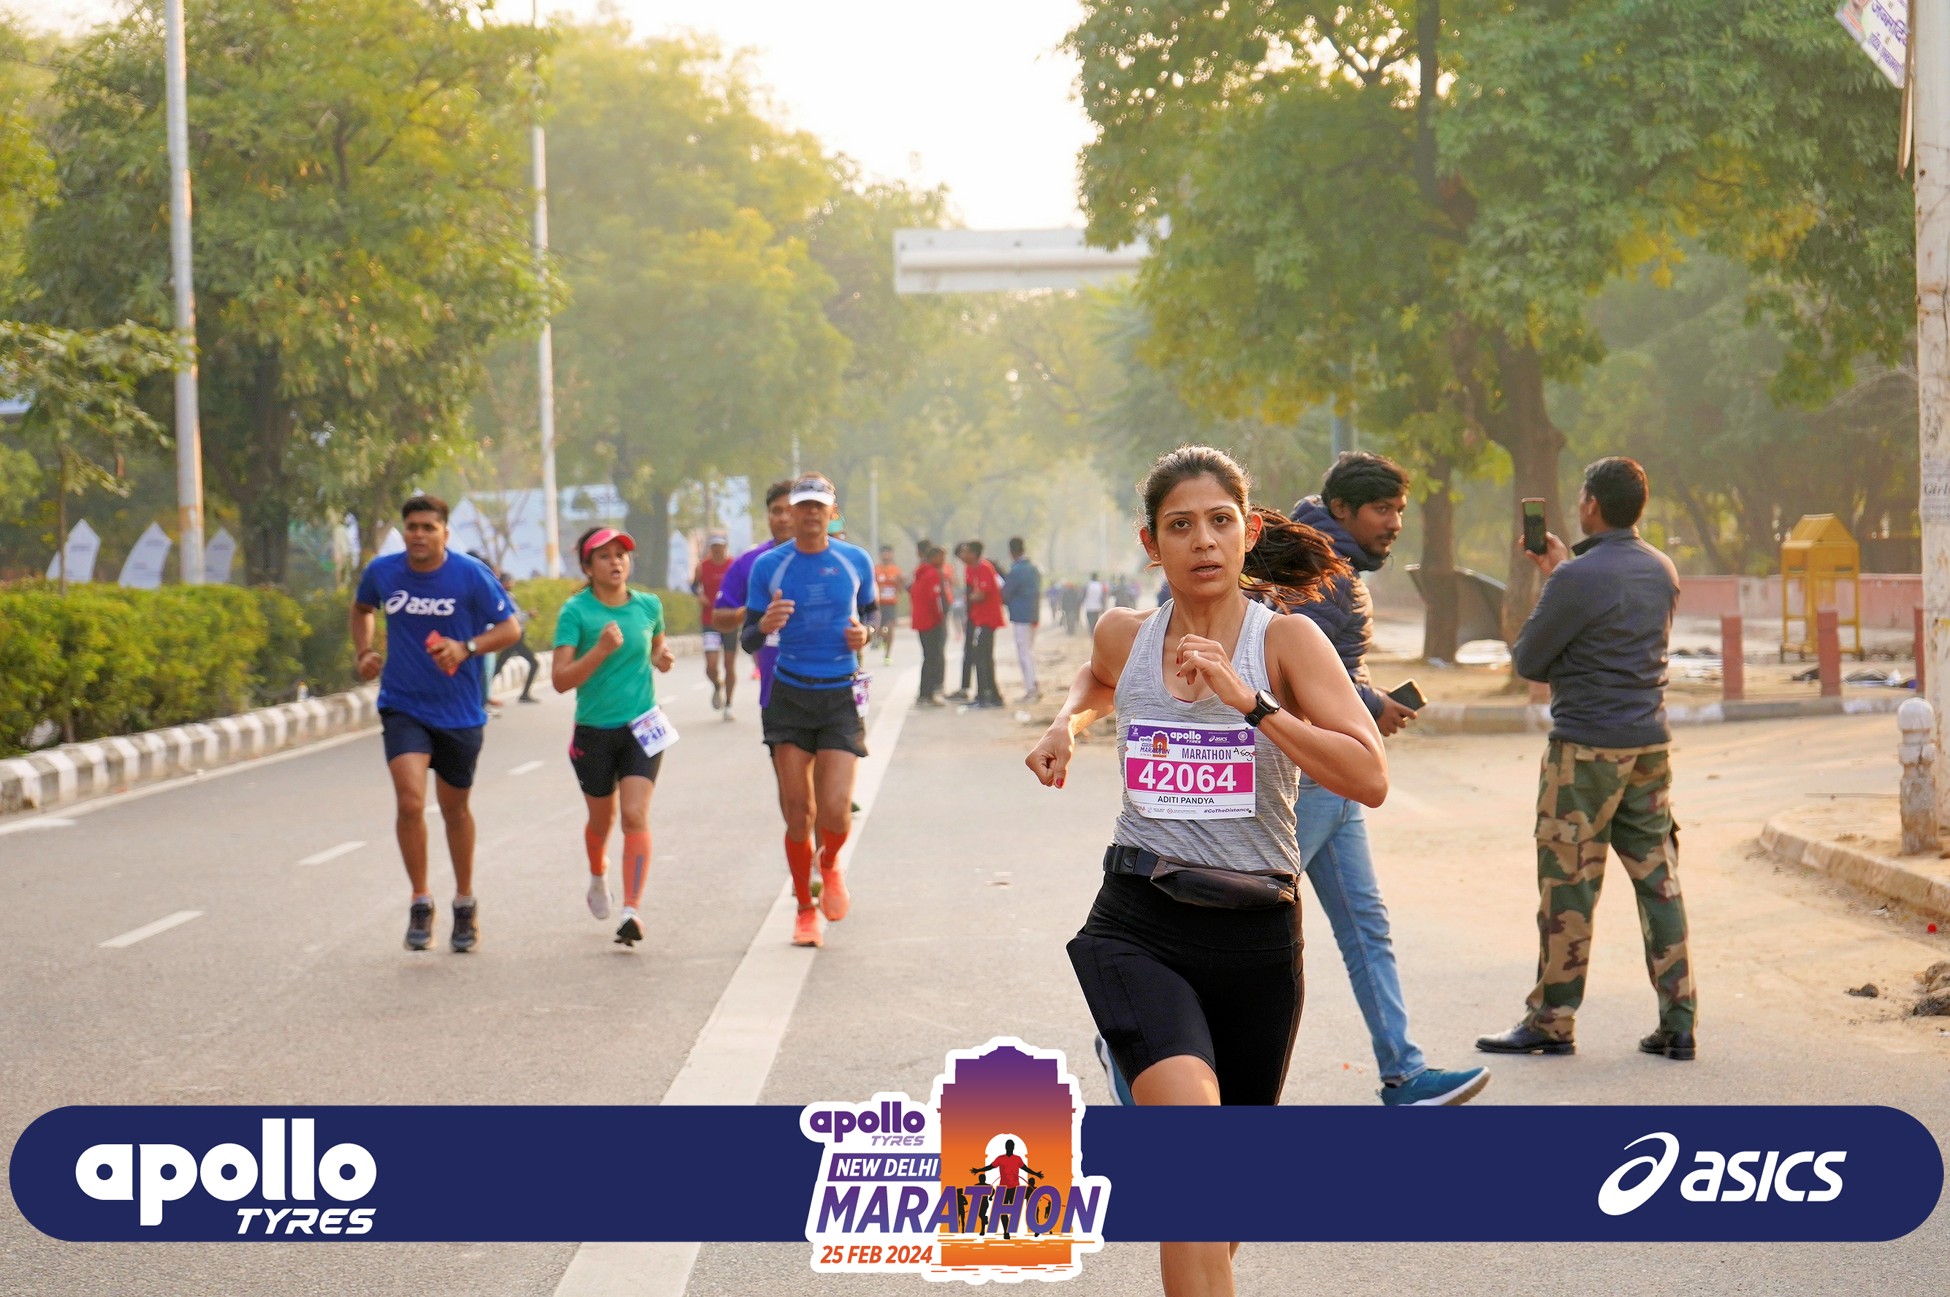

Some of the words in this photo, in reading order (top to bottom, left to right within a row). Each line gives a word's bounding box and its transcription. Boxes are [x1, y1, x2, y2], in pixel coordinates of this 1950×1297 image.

[1170, 730, 1202, 742] apollo
[1181, 747, 1232, 760] MARATHON
[1138, 761, 1237, 793] 42064
[1157, 795, 1179, 804] ADITI
[1180, 797, 1215, 805] PANDYA
